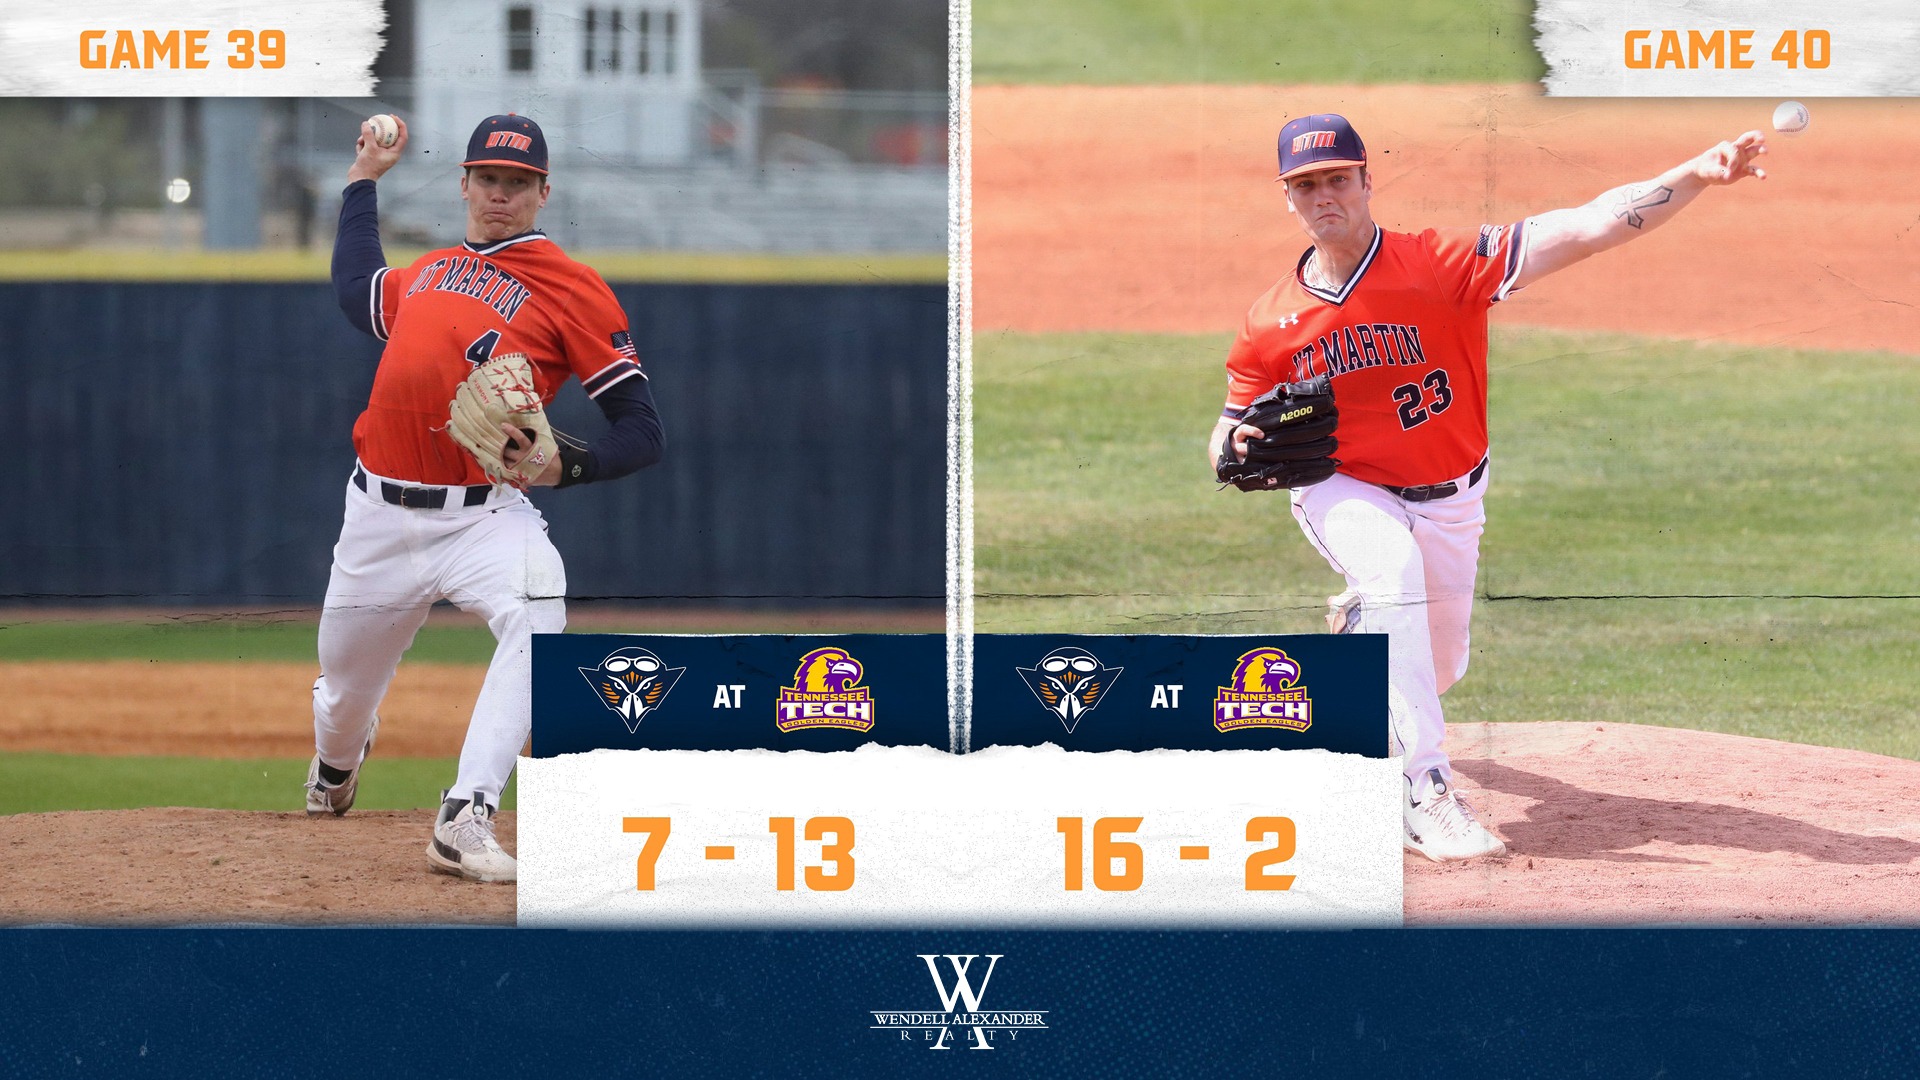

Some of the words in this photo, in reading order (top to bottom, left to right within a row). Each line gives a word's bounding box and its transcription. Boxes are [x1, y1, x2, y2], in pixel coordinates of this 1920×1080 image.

[485, 131, 532, 152] UTM
[1291, 131, 1336, 155] UTM
[434, 256, 532, 324] MARTIN
[465, 328, 502, 370] 4
[1318, 323, 1427, 380] MARTIN
[1279, 405, 1313, 423] A2000
[1391, 368, 1454, 431] 23
